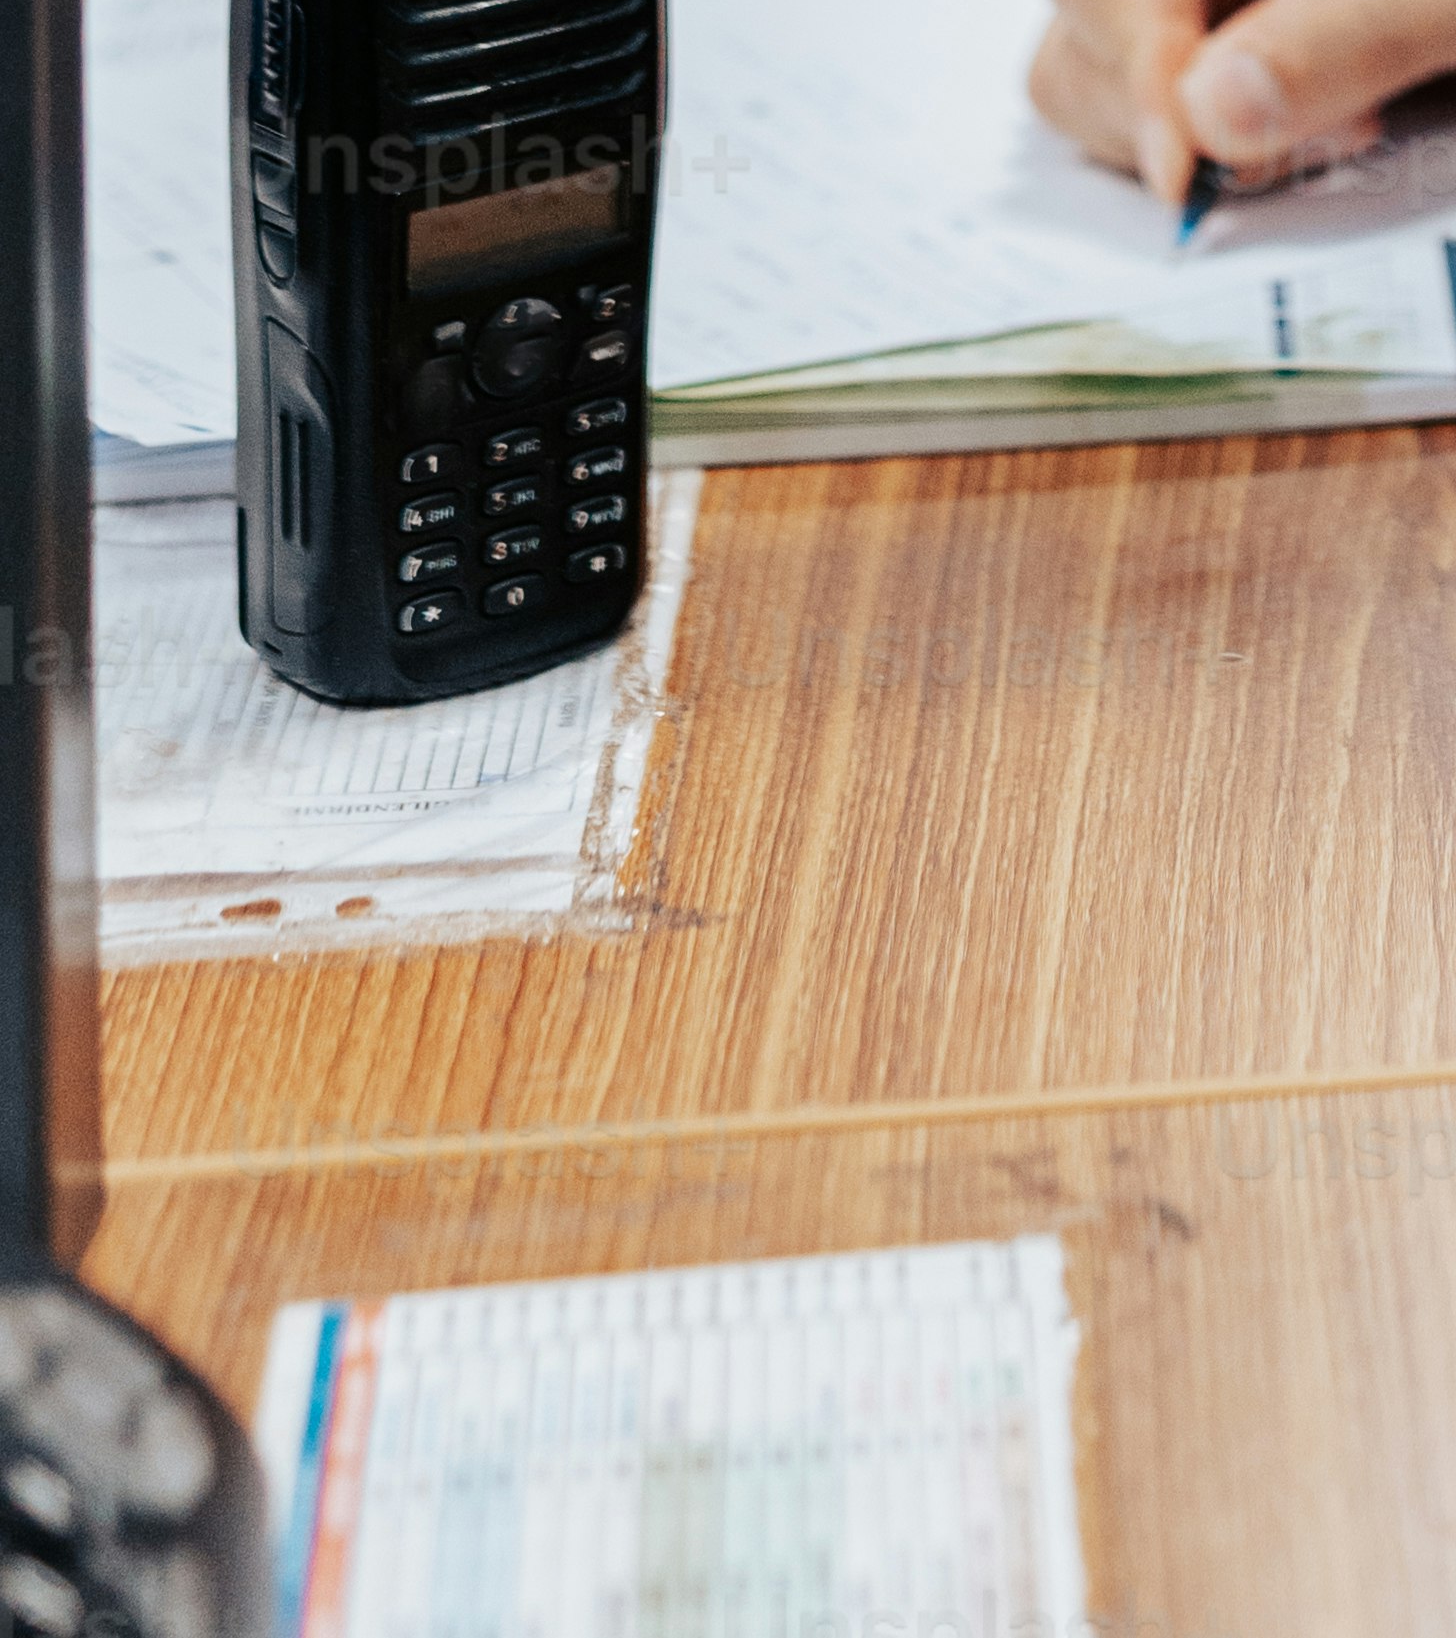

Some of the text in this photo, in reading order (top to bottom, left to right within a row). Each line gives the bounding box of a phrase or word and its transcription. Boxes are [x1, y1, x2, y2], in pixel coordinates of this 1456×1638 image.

[492, 441, 508, 461] 2
[425, 454, 438, 474] 1
[572, 462, 589, 481] 6
[491, 491, 506, 511] 5
[409, 510, 423, 527] 4
[572, 510, 589, 529] 9
[408, 556, 423, 578] 7
[507, 586, 525, 606] 0
